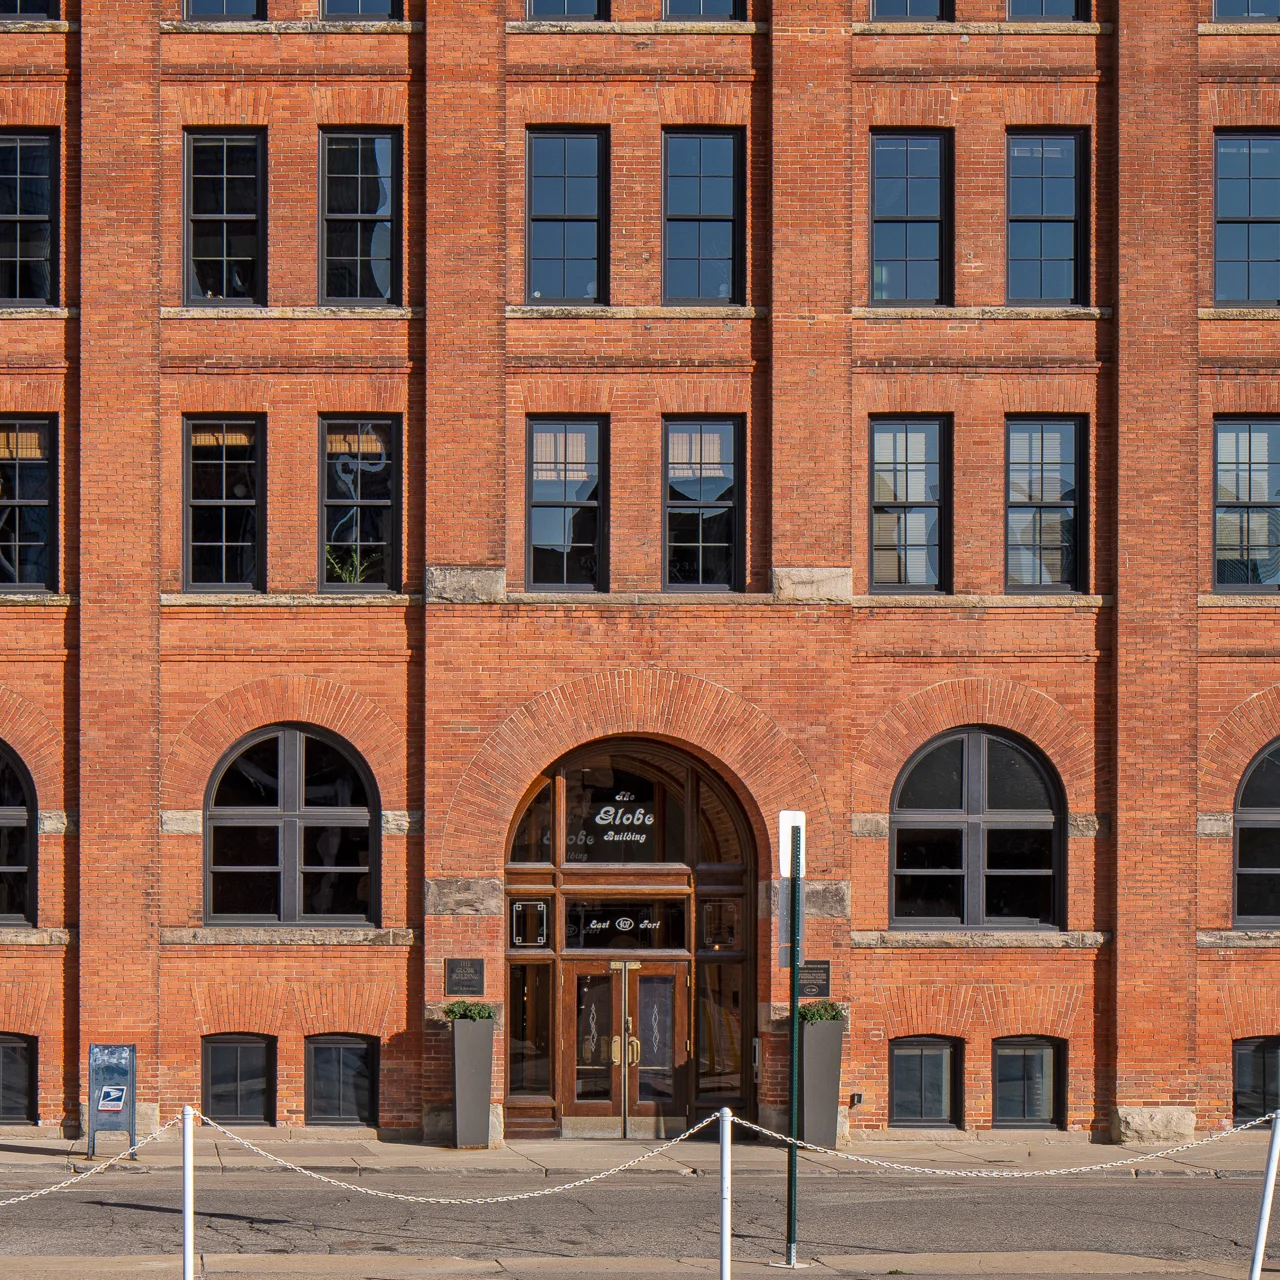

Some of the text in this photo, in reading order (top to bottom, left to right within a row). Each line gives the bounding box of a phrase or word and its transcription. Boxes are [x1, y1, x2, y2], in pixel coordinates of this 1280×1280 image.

[615, 791, 635, 801] The
[595, 806, 654, 825] Globe
[603, 831, 646, 843] Building
[590, 920, 610, 929] East
[639, 920, 660, 929] Fort
